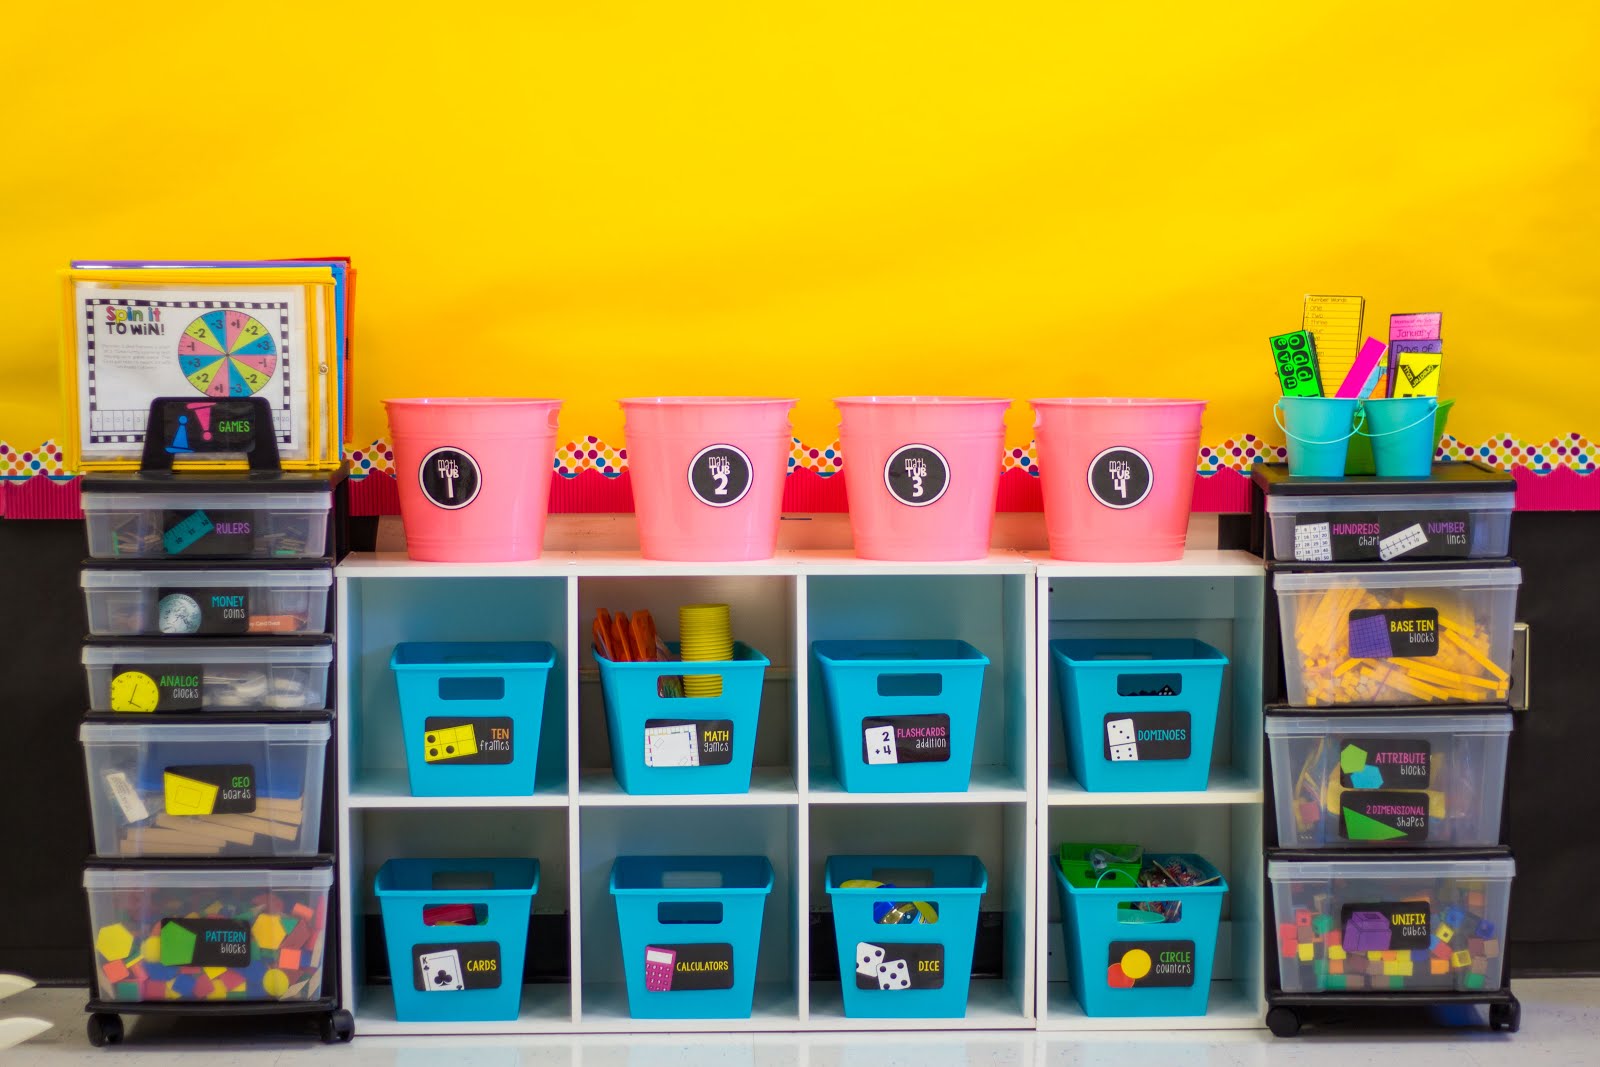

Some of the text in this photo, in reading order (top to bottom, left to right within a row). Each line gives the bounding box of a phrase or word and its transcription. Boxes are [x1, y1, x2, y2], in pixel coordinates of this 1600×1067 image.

[106, 305, 161, 325] Spin it
[105, 322, 127, 335] TO
[193, 328, 206, 338] -2
[245, 325, 258, 335] +2
[1396, 328, 1432, 338] January
[1396, 343, 1433, 353] Days of
[1274, 338, 1297, 389] even
[1289, 334, 1313, 381] odd
[195, 373, 209, 383] +2
[245, 373, 258, 384] -2
[218, 421, 250, 433] GAMES
[437, 459, 459, 470] math
[708, 456, 730, 467] math
[904, 458, 927, 469] math
[1109, 460, 1130, 471] math
[438, 468, 459, 479] TUB
[708, 465, 731, 475] TUB
[905, 467, 927, 477] TUB
[1109, 469, 1131, 480] TUB
[447, 477, 454, 498] 1
[713, 473, 728, 495] 2
[912, 476, 924, 497] 3
[1114, 479, 1127, 498] 4
[216, 522, 250, 534] RULERS
[1332, 523, 1380, 535] HUNDREDS
[1428, 522, 1465, 534] NUMBER
[1447, 534, 1466, 545] lines
[211, 595, 245, 607] MONEY
[223, 608, 245, 619] coins
[1390, 620, 1434, 633] BASE TEN
[1409, 632, 1435, 643] blocks
[160, 675, 199, 687] ANALOG
[173, 688, 199, 699] clocks
[491, 728, 510, 740] TEN
[704, 730, 729, 742] MATH
[882, 731, 890, 742] 2
[897, 726, 946, 738] FLASHCARDS
[1138, 729, 1186, 741] DOMINOES
[480, 739, 510, 751] frames
[703, 741, 729, 753] games
[915, 737, 947, 749] addition
[883, 745, 892, 755] 4
[1375, 752, 1426, 764] ATTRIBUTE
[1400, 764, 1426, 776] blocks
[232, 776, 250, 788] GEO
[222, 788, 251, 800] boards
[1366, 805, 1425, 816] 2 DIMENSIONAL
[1396, 816, 1425, 827] shapes
[1392, 913, 1426, 925] UNIFIX
[1402, 925, 1427, 936] cubes
[205, 931, 246, 943] PATTERN
[220, 943, 247, 954] blocks
[1160, 951, 1191, 963] CIRCLE
[466, 959, 497, 971] CARDS
[676, 961, 729, 972] CALCULATORS
[918, 960, 940, 972] DICE
[1155, 963, 1191, 974] counters
